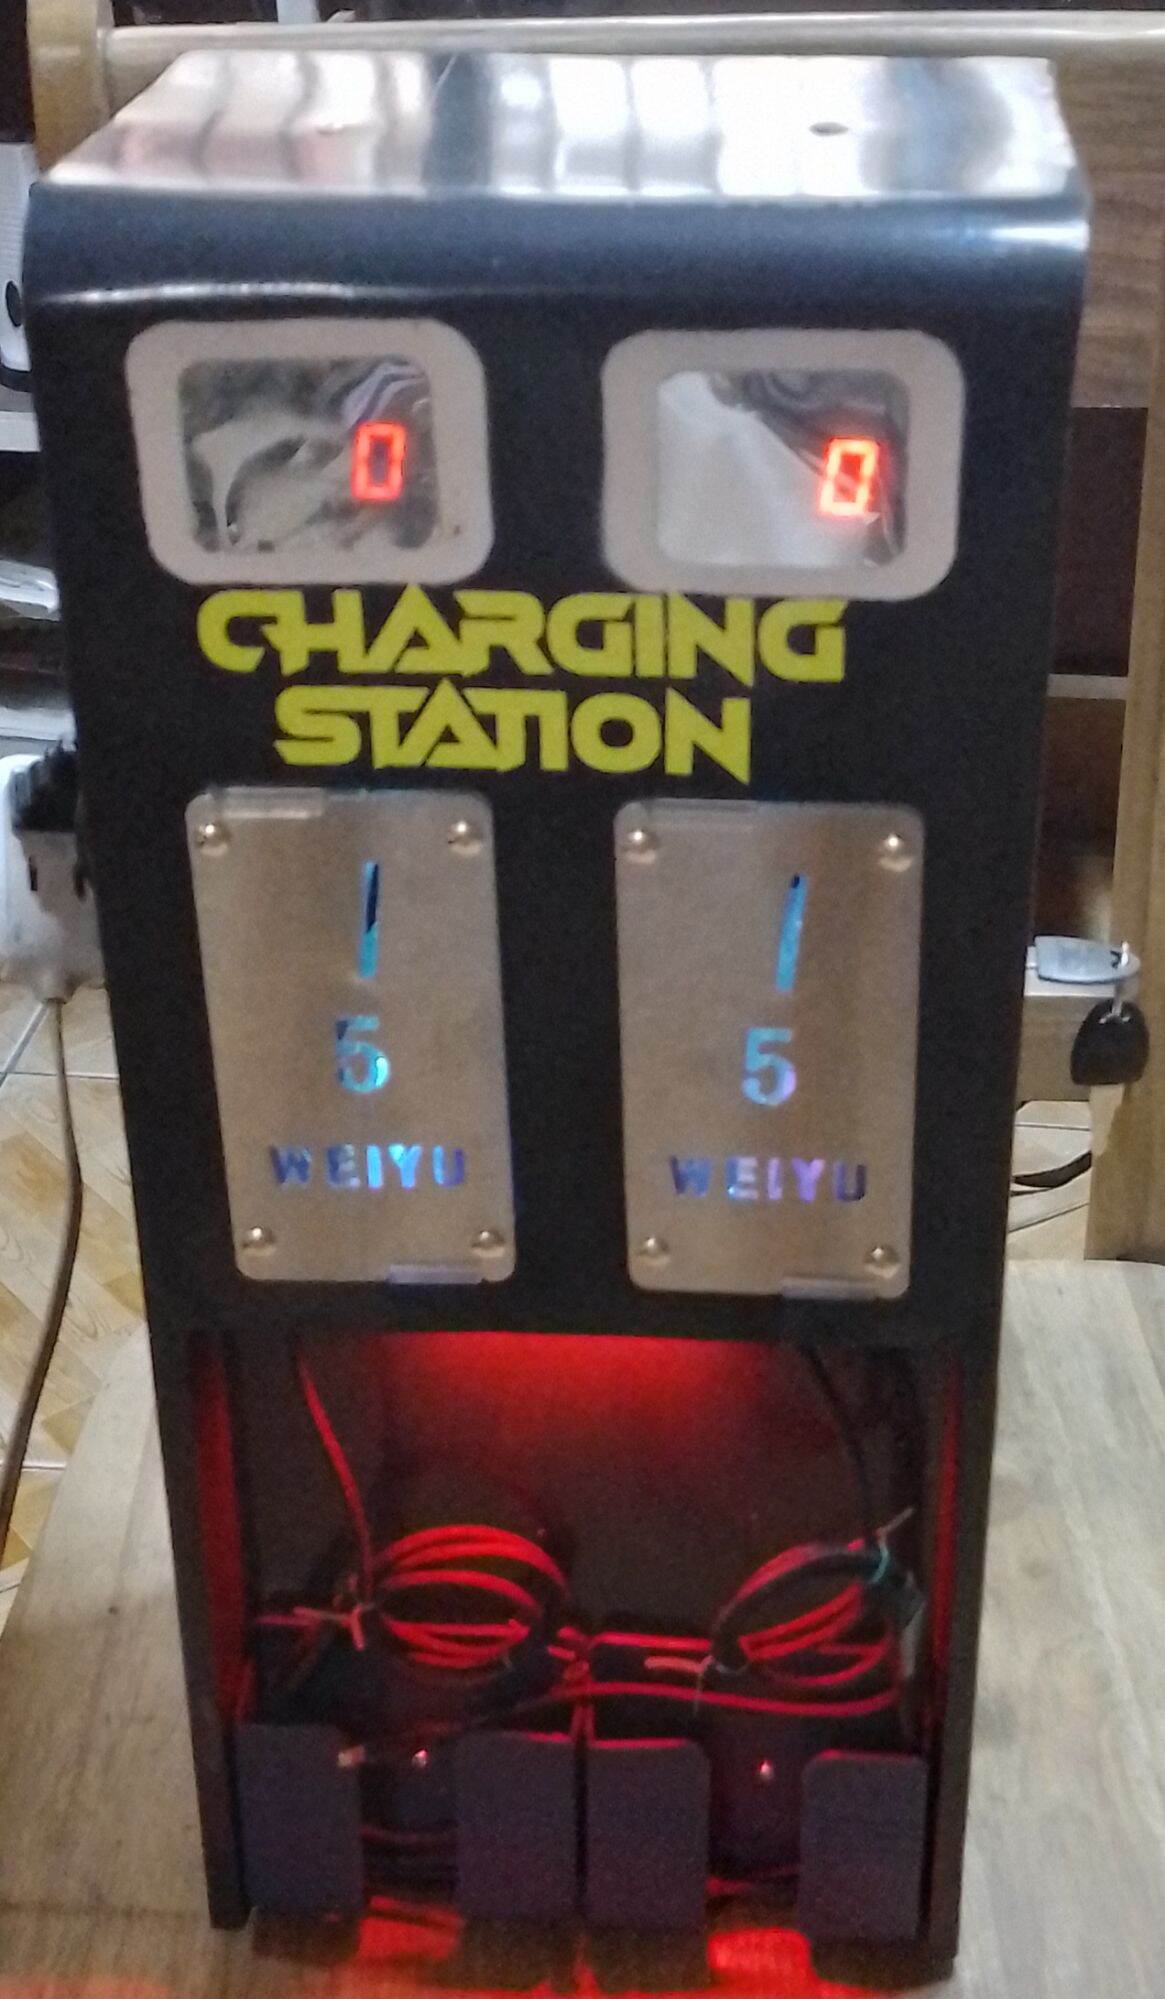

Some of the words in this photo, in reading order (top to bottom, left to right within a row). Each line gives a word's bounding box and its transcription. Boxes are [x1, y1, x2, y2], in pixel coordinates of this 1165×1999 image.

[352, 421, 405, 502] 0
[819, 437, 881, 518] 0
[197, 584, 848, 687] CHARGING
[273, 679, 753, 785] STATION
[334, 1014, 391, 1094] 5
[741, 1026, 797, 1107] 5
[269, 1143, 465, 1190] WEIYU
[669, 1155, 868, 1202] WEIYU
